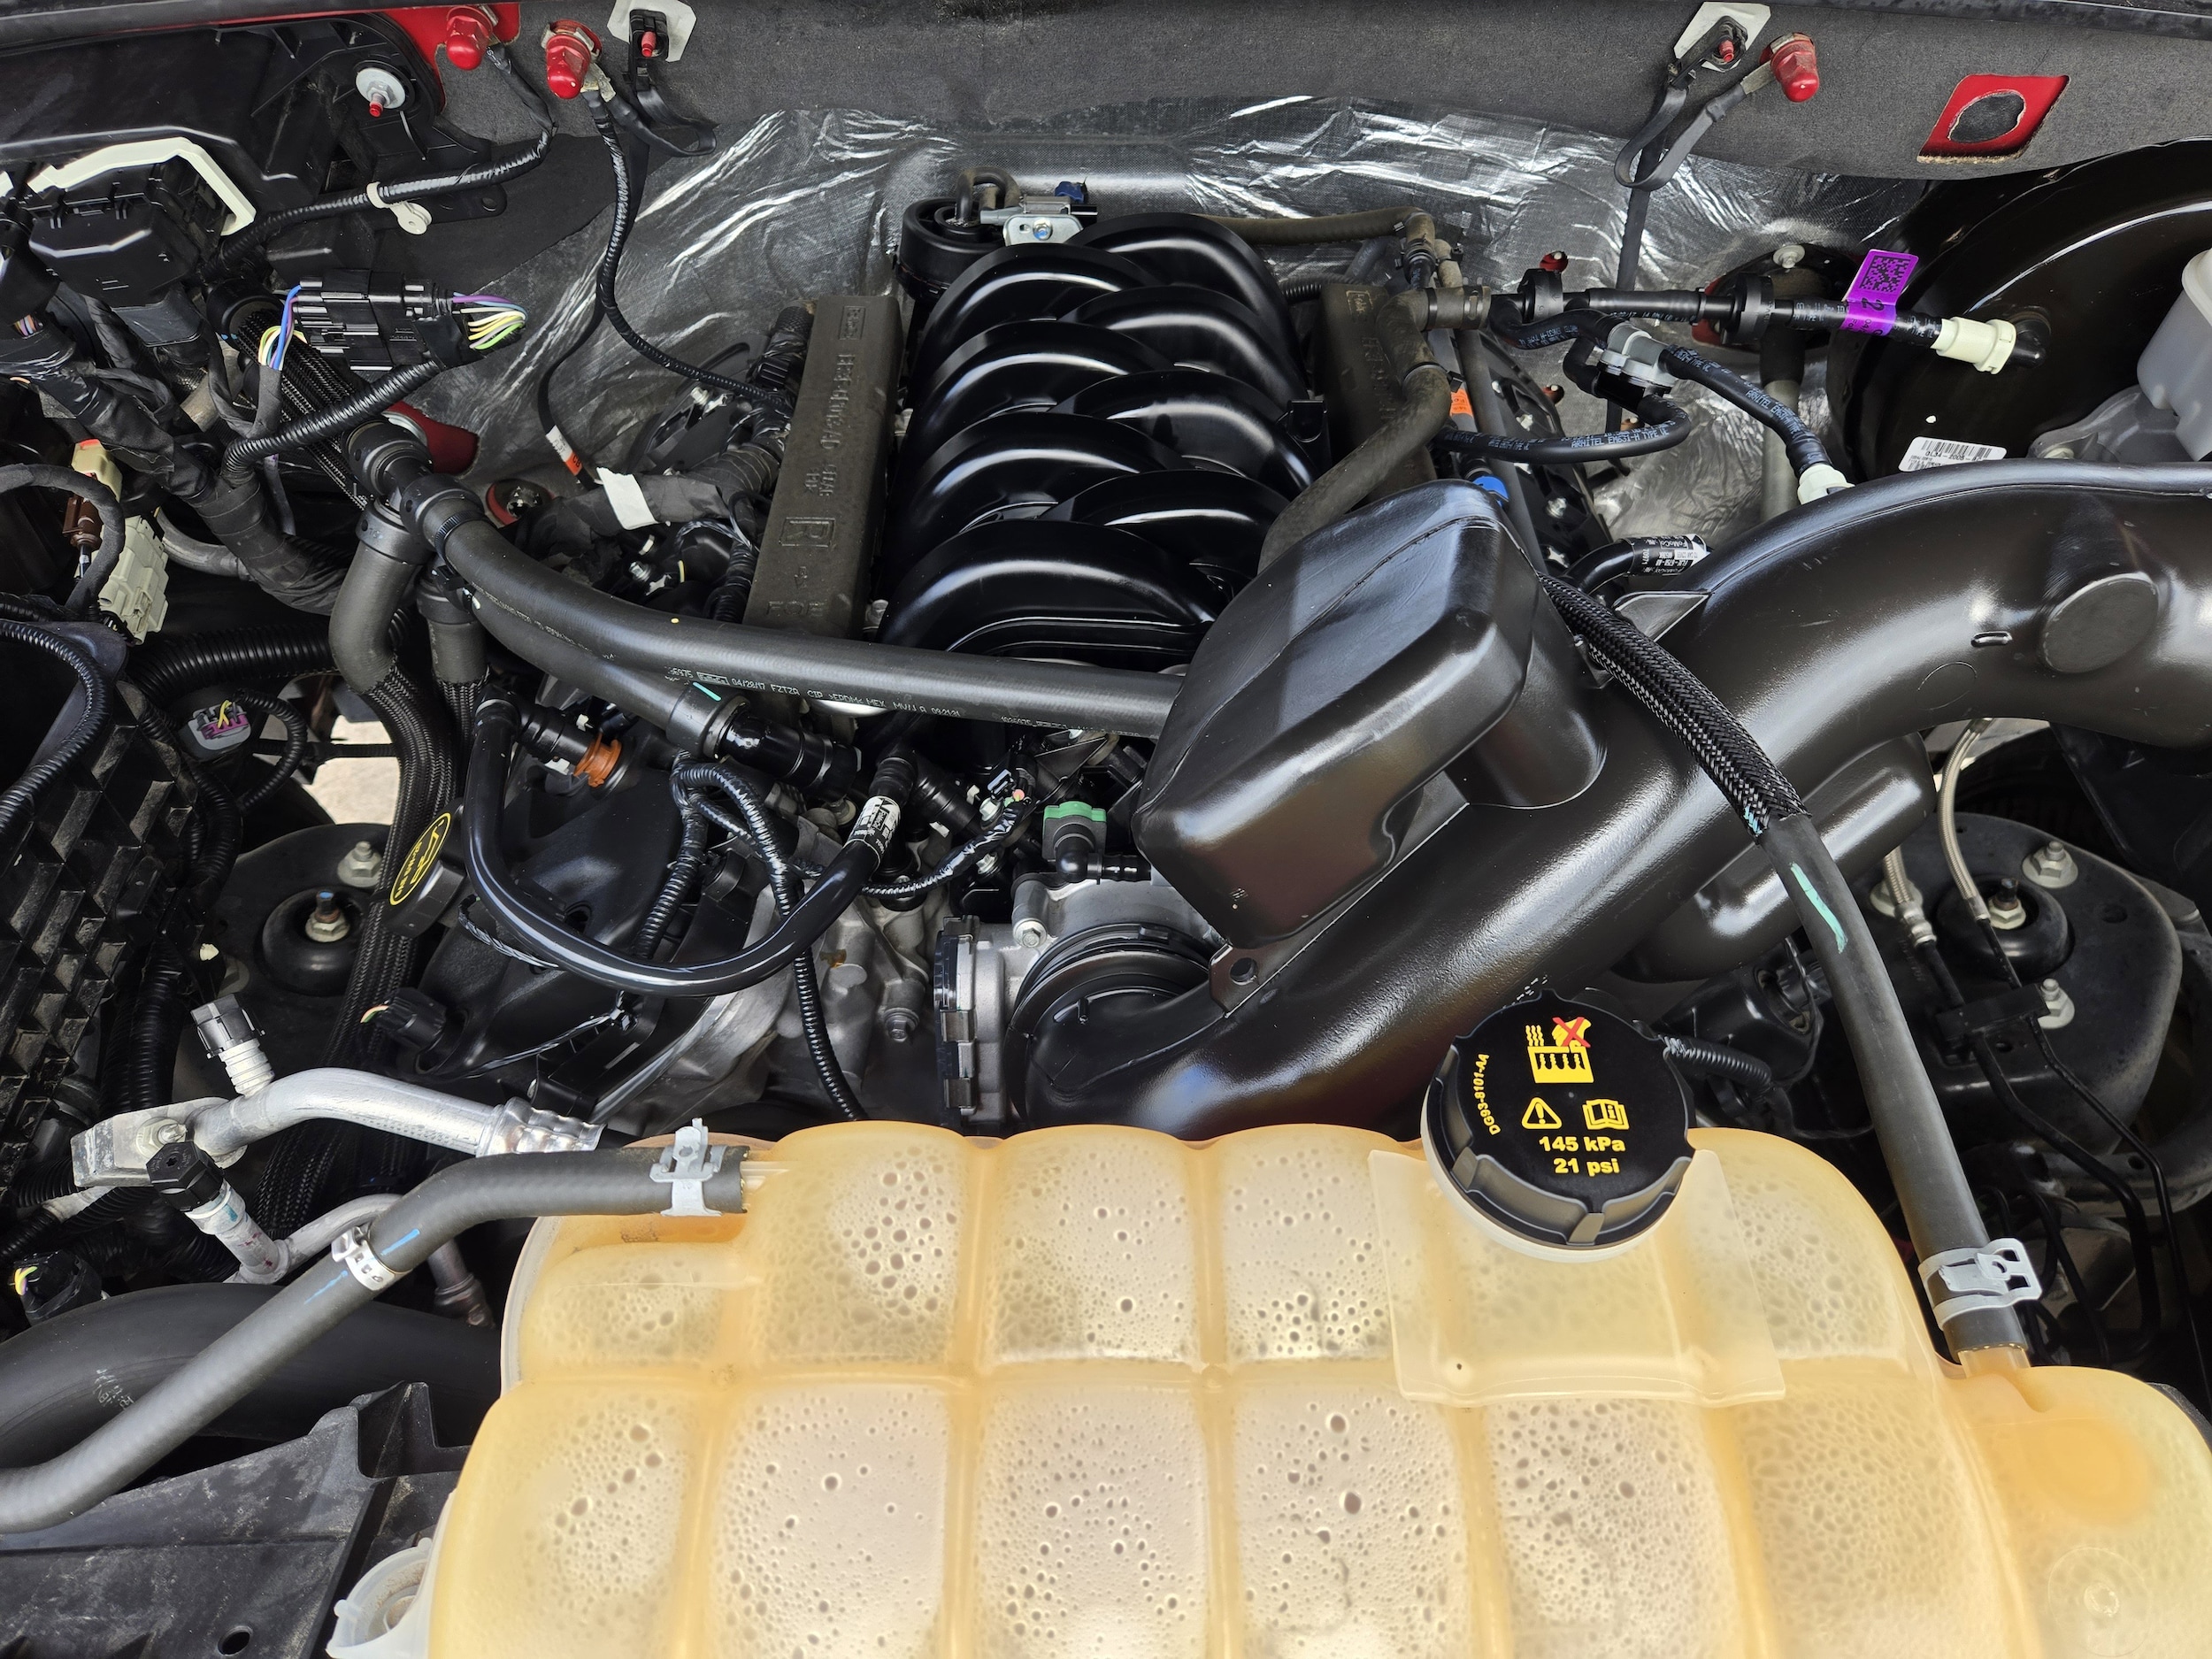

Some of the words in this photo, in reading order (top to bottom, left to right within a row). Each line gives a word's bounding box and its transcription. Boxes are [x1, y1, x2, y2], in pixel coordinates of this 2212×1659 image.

[1641, 428, 1659, 440] TYPE
[865, 697, 887, 708] MEX
[1539, 1135, 1579, 1153] 145
[1585, 1135, 1626, 1153] kPa
[1553, 1158, 1579, 1174] 21
[1586, 1158, 1620, 1177] psi
